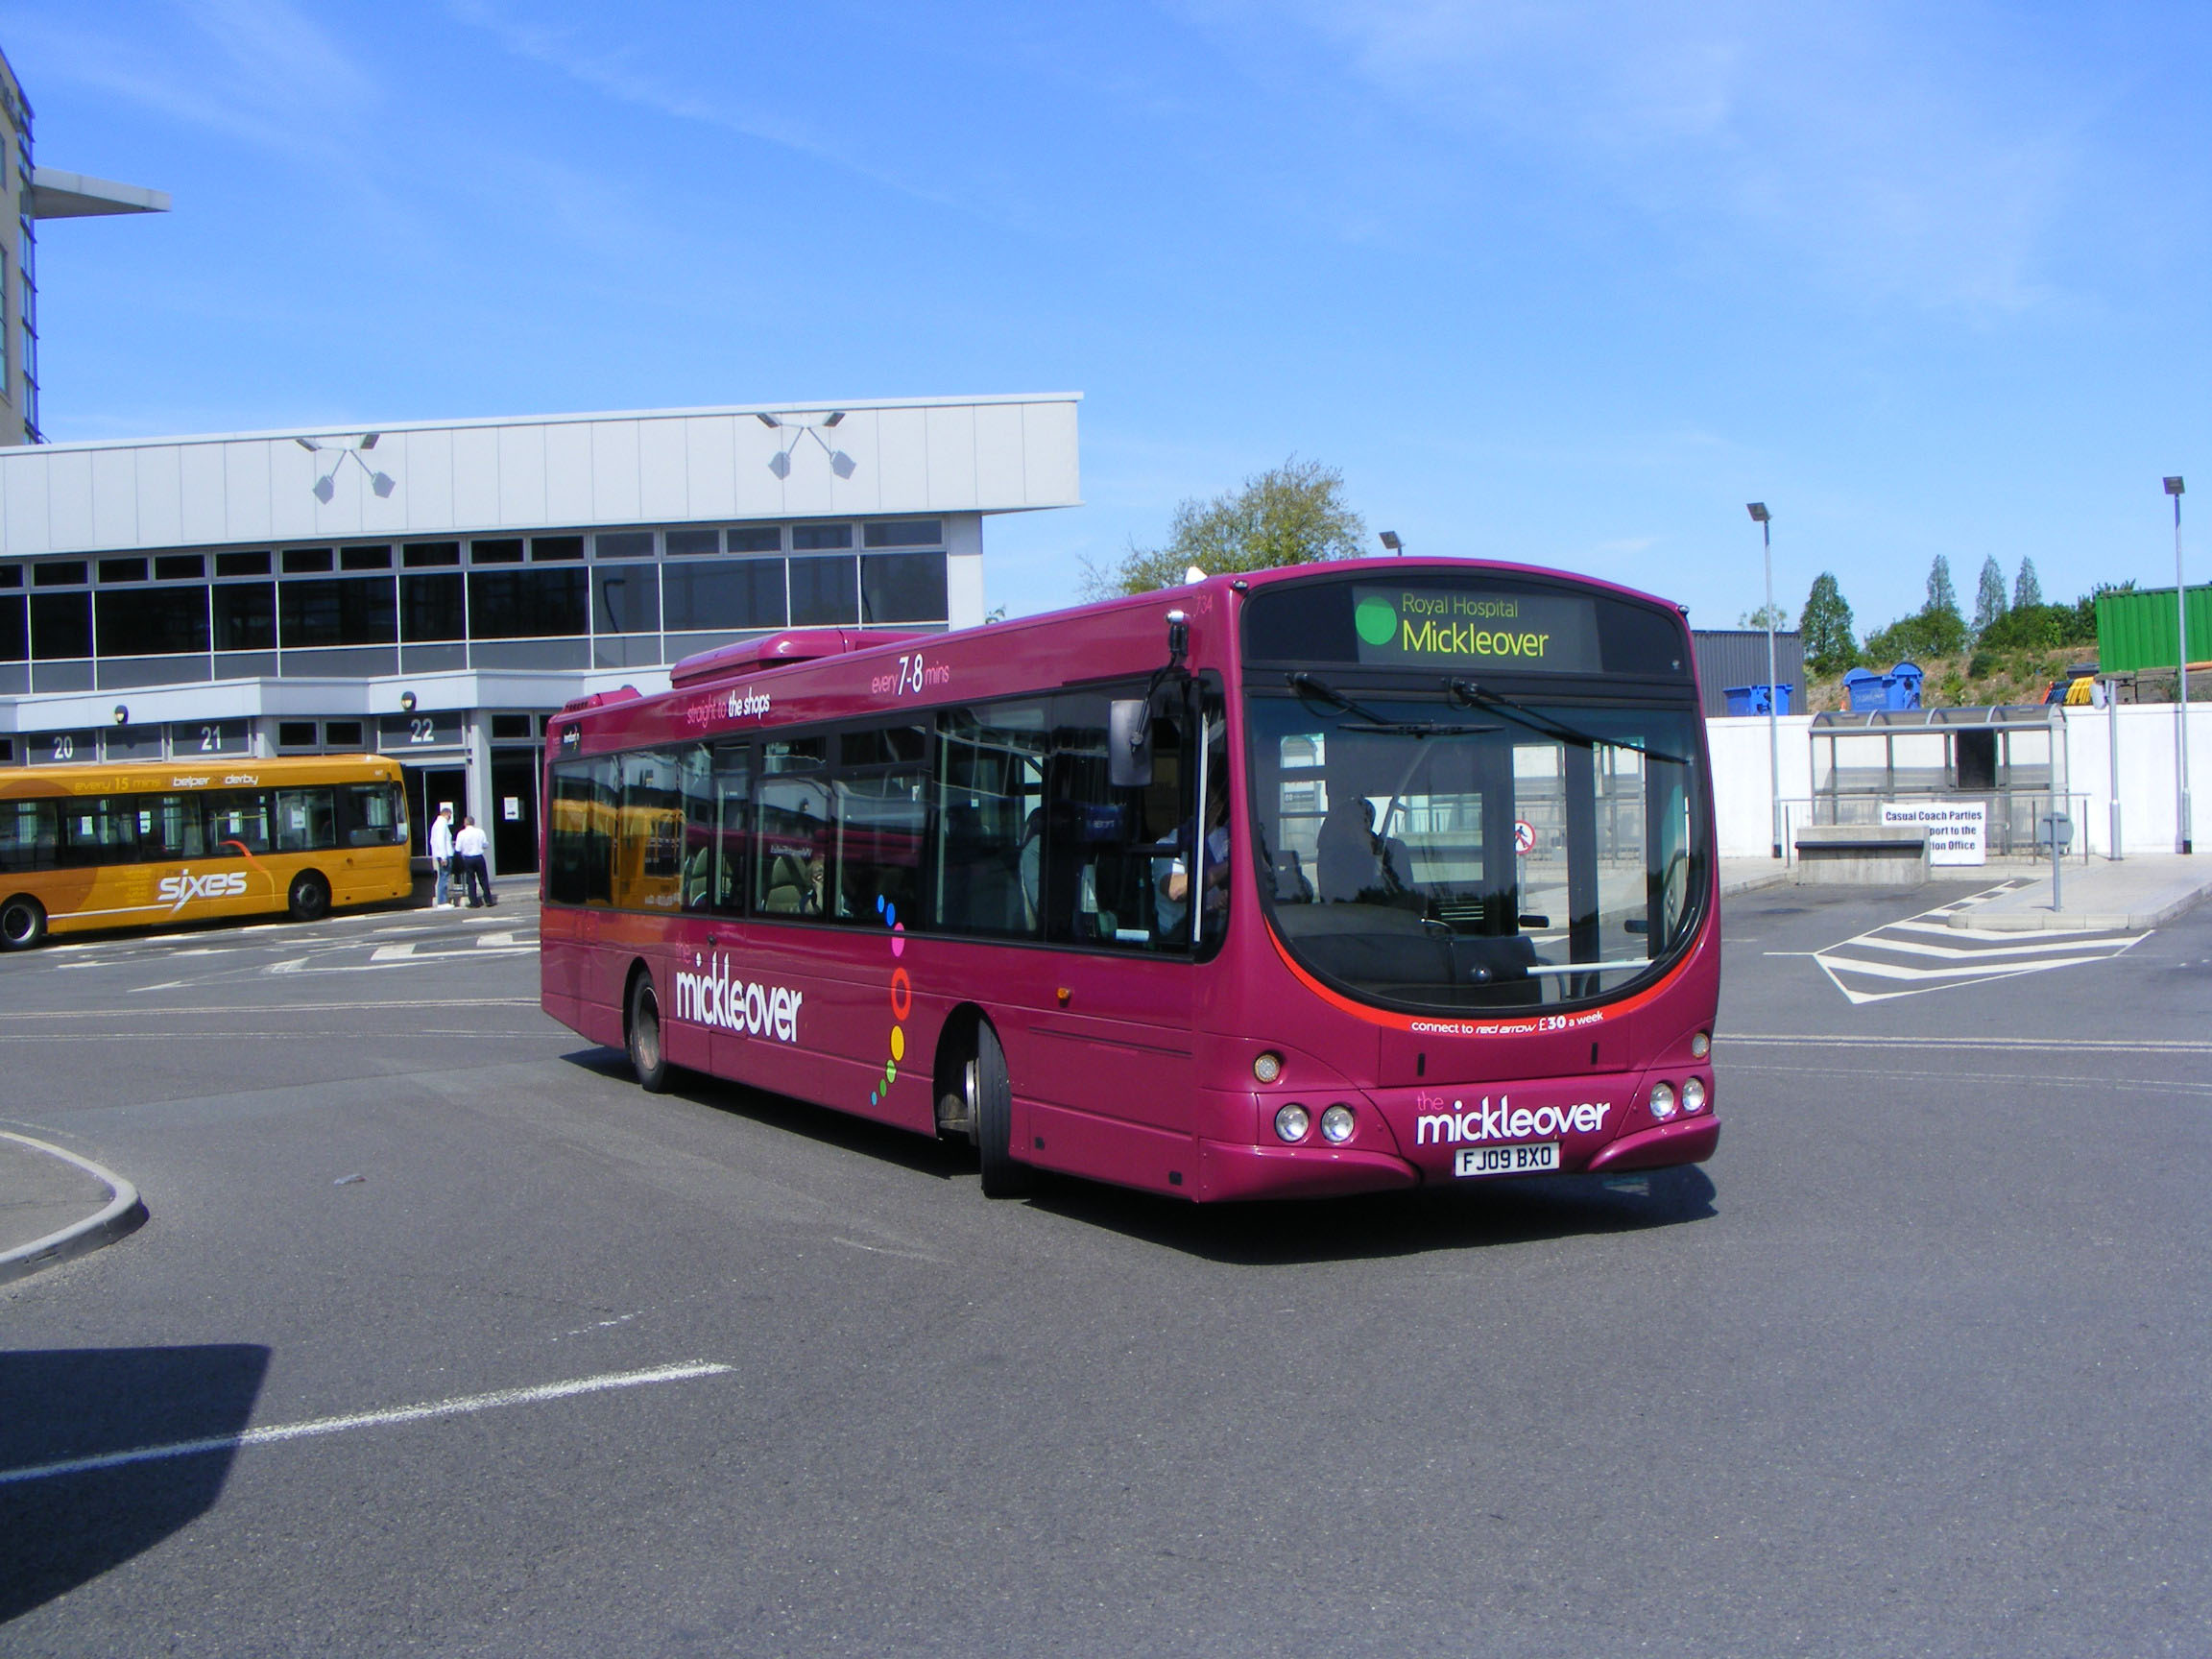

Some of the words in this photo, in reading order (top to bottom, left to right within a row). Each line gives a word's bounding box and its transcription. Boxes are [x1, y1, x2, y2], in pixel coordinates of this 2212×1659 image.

[1403, 593, 1449, 615] Royal
[1454, 595, 1519, 619] Hospital
[1403, 619, 1550, 657] Mickleover
[872, 674, 899, 694] every
[898, 653, 923, 695] 7-8
[925, 661, 950, 685] mins
[687, 693, 716, 729] straight
[718, 700, 727, 719] to
[729, 689, 743, 718] the
[743, 686, 770, 720] shops
[202, 726, 222, 751] 21
[411, 718, 434, 742] 22
[54, 736, 73, 759] 20
[75, 781, 109, 791] every
[114, 778, 129, 790] 15
[132, 777, 161, 788] mins
[173, 775, 210, 787] belper
[225, 774, 259, 785] derby
[1886, 811, 1916, 821] Casual
[1918, 811, 1947, 821] Coach
[1949, 810, 1983, 821] Parties
[1930, 827, 1948, 836] port
[1951, 827, 1960, 835] to
[1961, 826, 1977, 835] the
[1948, 840, 1976, 851] Office
[157, 869, 247, 913] sixes
[676, 950, 803, 1043] mickleover
[1411, 1021, 1459, 1034] connect
[1461, 1022, 1474, 1034] to
[1476, 1023, 1499, 1034] red
[1500, 1023, 1536, 1034] arrow
[1538, 1015, 1566, 1032] £30
[1569, 1019, 1575, 1027] a
[1576, 1010, 1603, 1024] week
[1417, 1092, 1444, 1111] the
[1416, 1094, 1611, 1144] mickleover
[1463, 1149, 1511, 1172] FJ09
[1517, 1146, 1551, 1168] BXO
